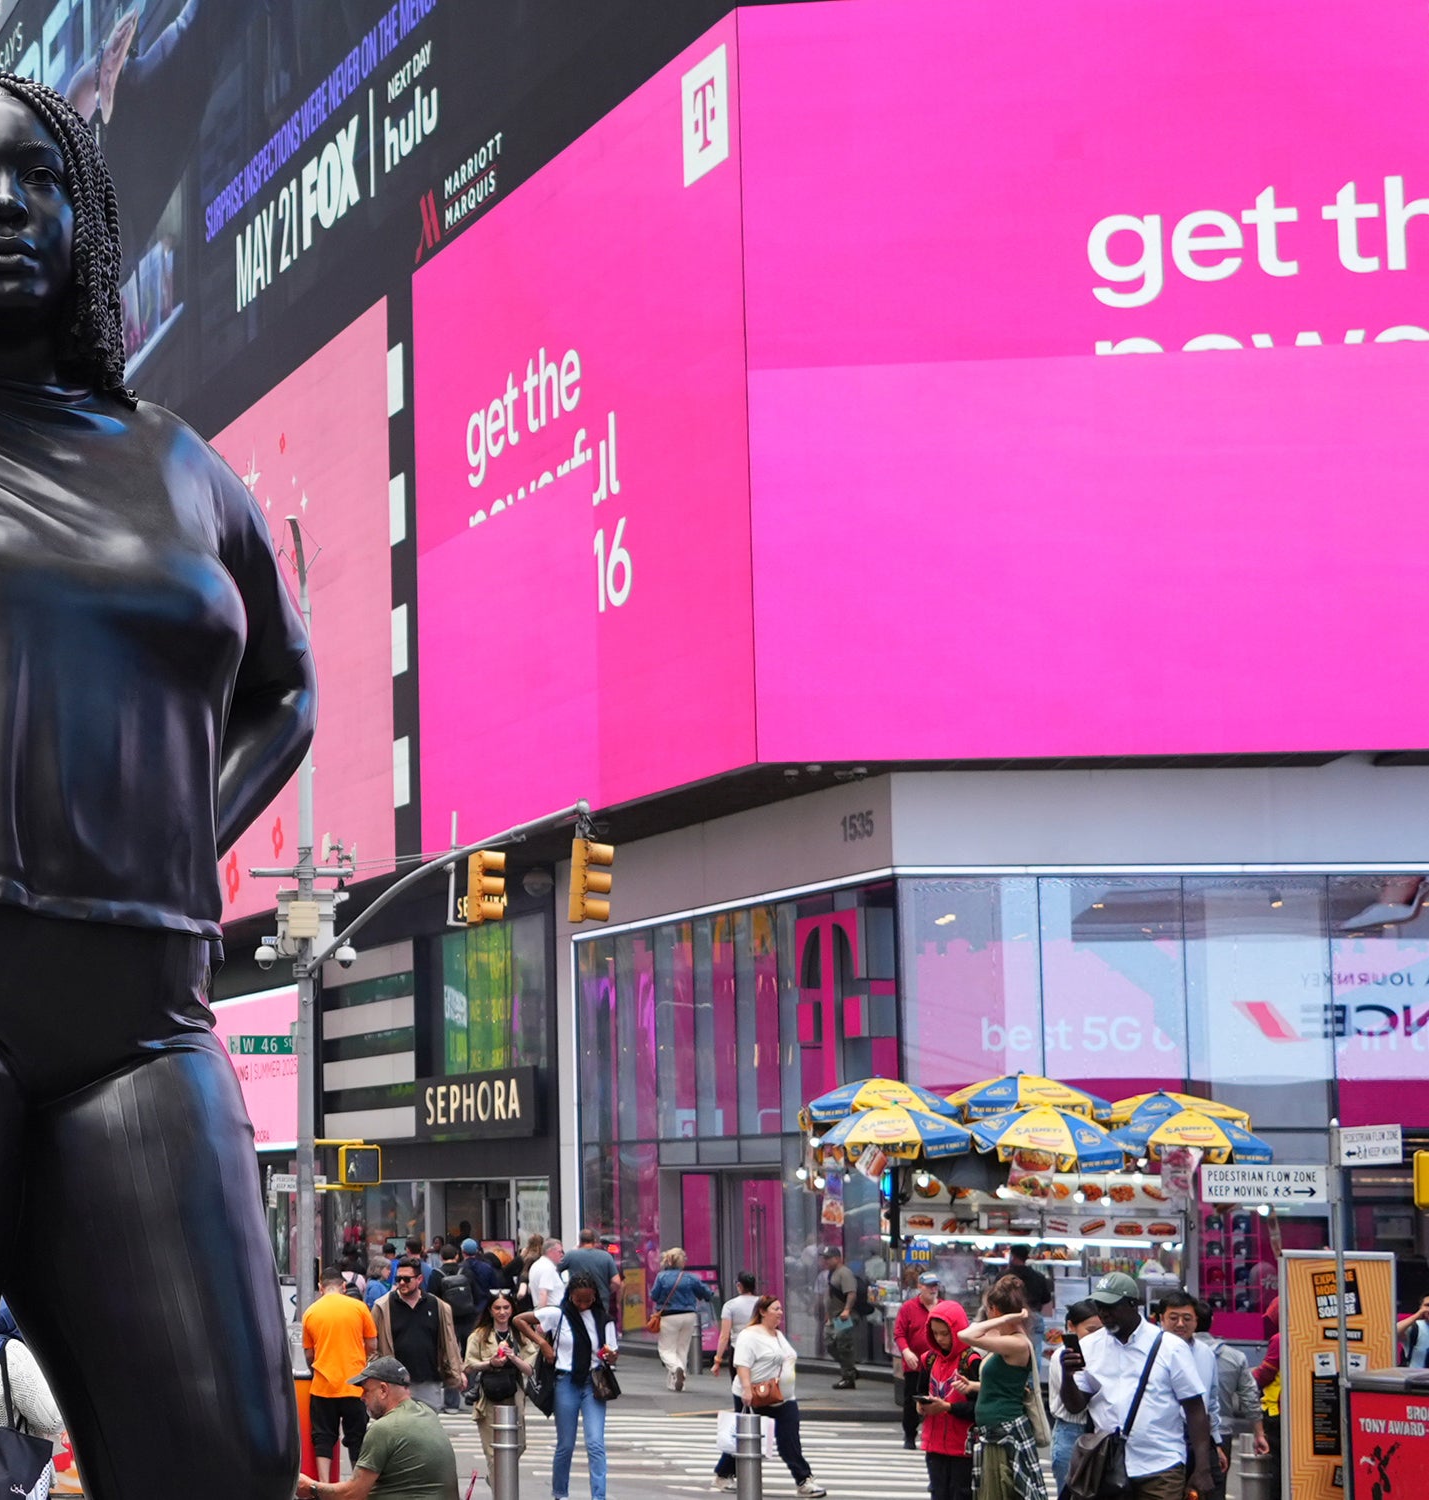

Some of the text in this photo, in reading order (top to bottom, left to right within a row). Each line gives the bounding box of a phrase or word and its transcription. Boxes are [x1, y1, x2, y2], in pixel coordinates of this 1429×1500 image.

[387, 40, 432, 103] NEXT DAY
[205, 178, 244, 243] SURPRISE
[244, 117, 301, 203] INSPECTIONS
[301, 82, 328, 142] WERE
[328, 47, 361, 115] NEVER
[361, 30, 378, 80] ON
[379, 9, 398, 62] THE
[384, 86, 438, 173] hulu
[444, 133, 502, 199] MARRIOTT
[235, 114, 360, 312] MAY 21 FOX
[445, 170, 496, 229] MARQUIS
[1087, 184, 1299, 307] get
[466, 371, 519, 488] get
[523, 347, 581, 433] the
[593, 516, 632, 613] 16
[841, 810, 874, 842] 1535
[242, 1037, 293, 1052] W 46 St
[980, 1015, 1143, 1052] best 5G
[253, 1060, 280, 1080] SUMMER
[426, 1078, 521, 1126] SEPHORA
[1386, 1130, 1398, 1141] ZONE
[1207, 1170, 1317, 1183] PEDESTRIAN FLOW ZONE
[1208, 1185, 1268, 1197] KEEP MOVING
[1316, 1285, 1338, 1296] MOR
[1328, 1292, 1356, 1305] TIES
[1318, 1303, 1356, 1318] SQURE
[1359, 1417, 1386, 1433] TONY
